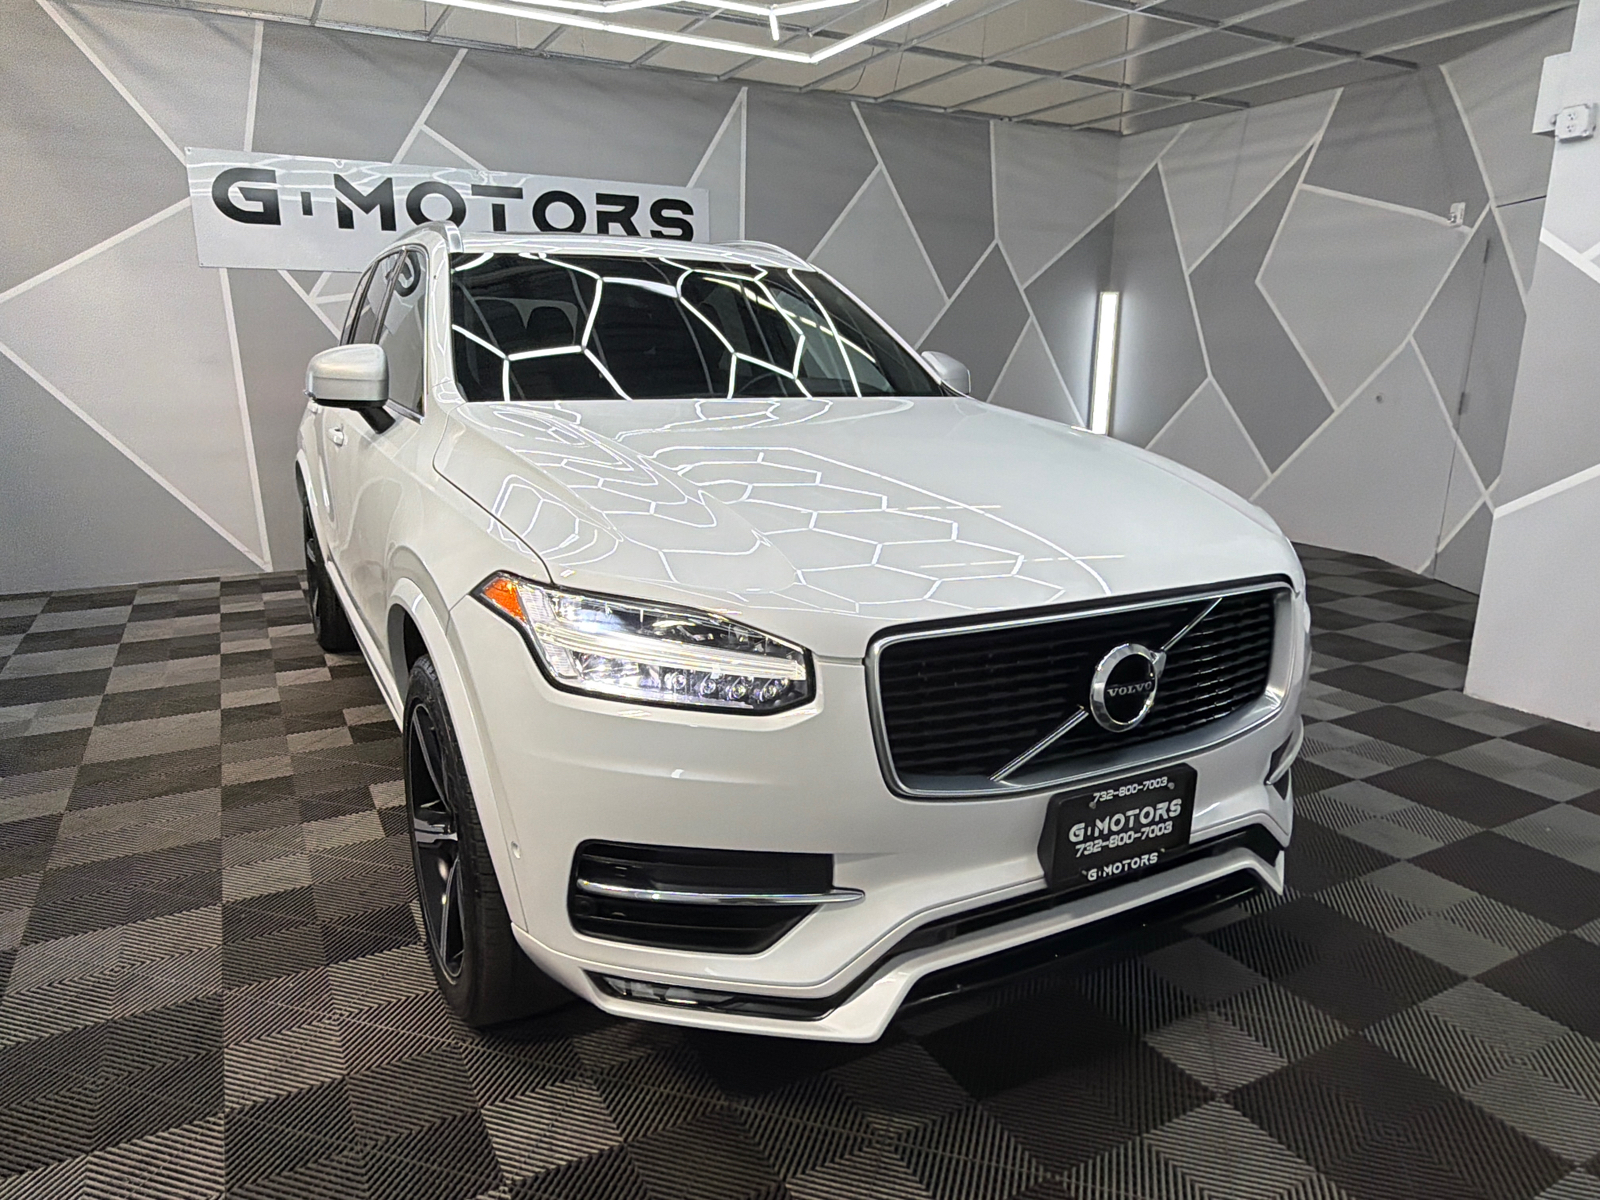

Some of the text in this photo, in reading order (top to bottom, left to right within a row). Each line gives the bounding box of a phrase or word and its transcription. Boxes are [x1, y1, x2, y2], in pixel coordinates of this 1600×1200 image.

[1107, 681, 1152, 697] VOLVO
[1093, 776, 1168, 803] 732-800-7003
[1075, 821, 1173, 858] 732-800-7003
